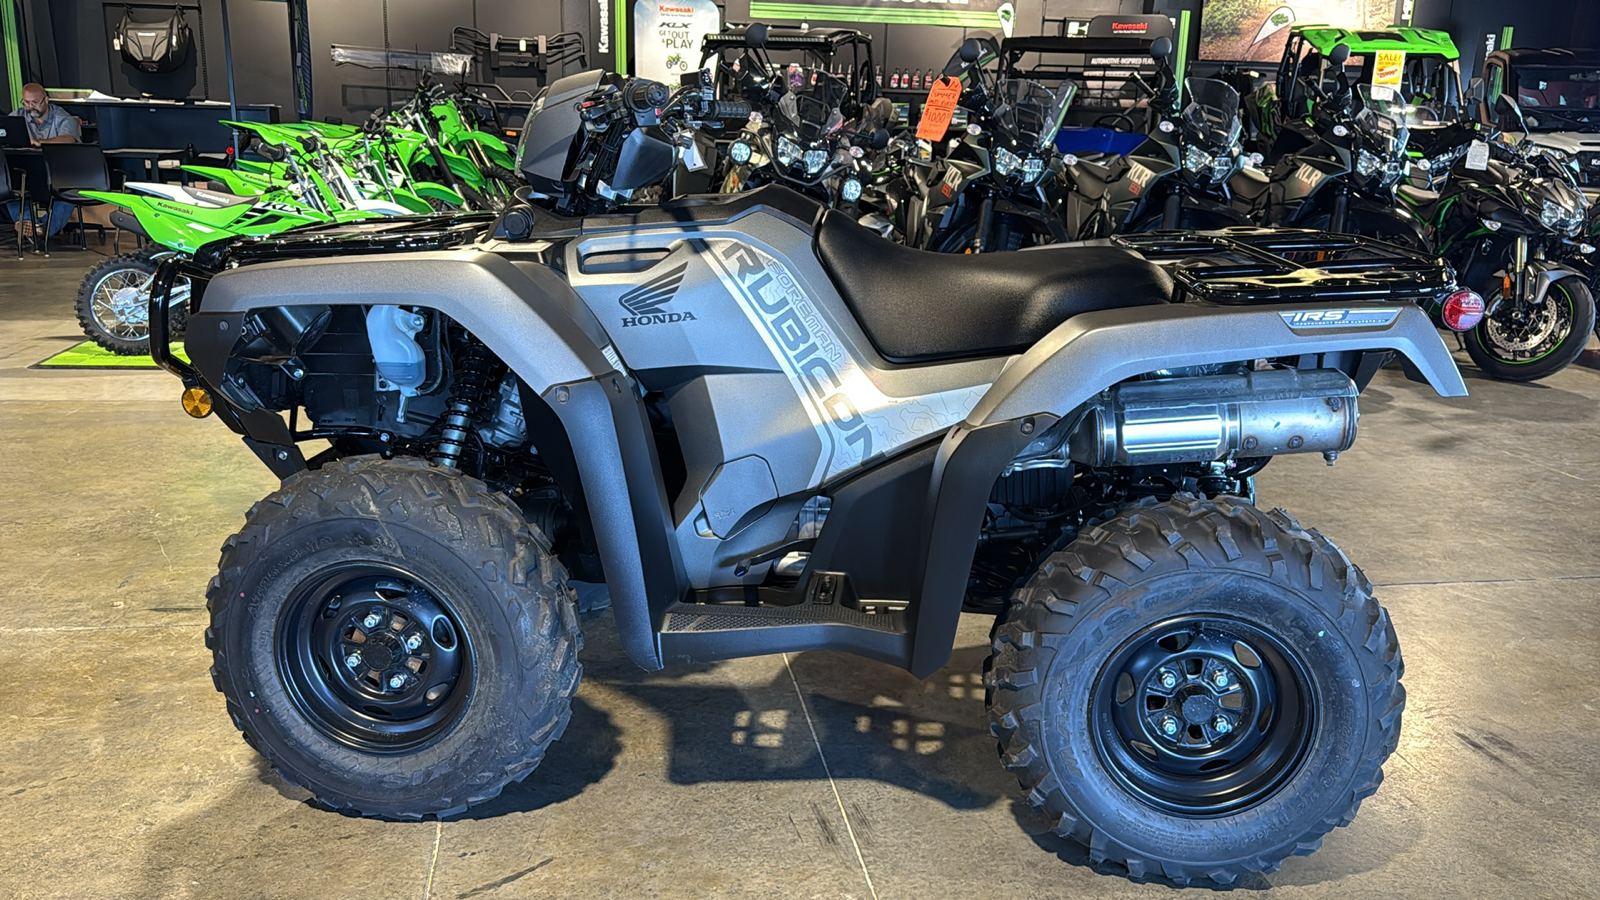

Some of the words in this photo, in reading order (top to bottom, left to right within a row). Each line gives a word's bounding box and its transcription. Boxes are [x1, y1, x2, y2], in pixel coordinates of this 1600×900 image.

[659, 5, 694, 13] Kawasaki
[671, 31, 690, 39] OUT
[666, 38, 694, 49] PLAY
[943, 163, 963, 192] KLR
[1127, 162, 1151, 188] KLR
[1294, 162, 1322, 188] KLR
[195, 191, 230, 204] Kawasaki
[157, 201, 194, 215] Kawasaki
[767, 259, 841, 363] FOREMAN
[1293, 311, 1345, 322] IRS
[621, 311, 698, 328] HONDA
